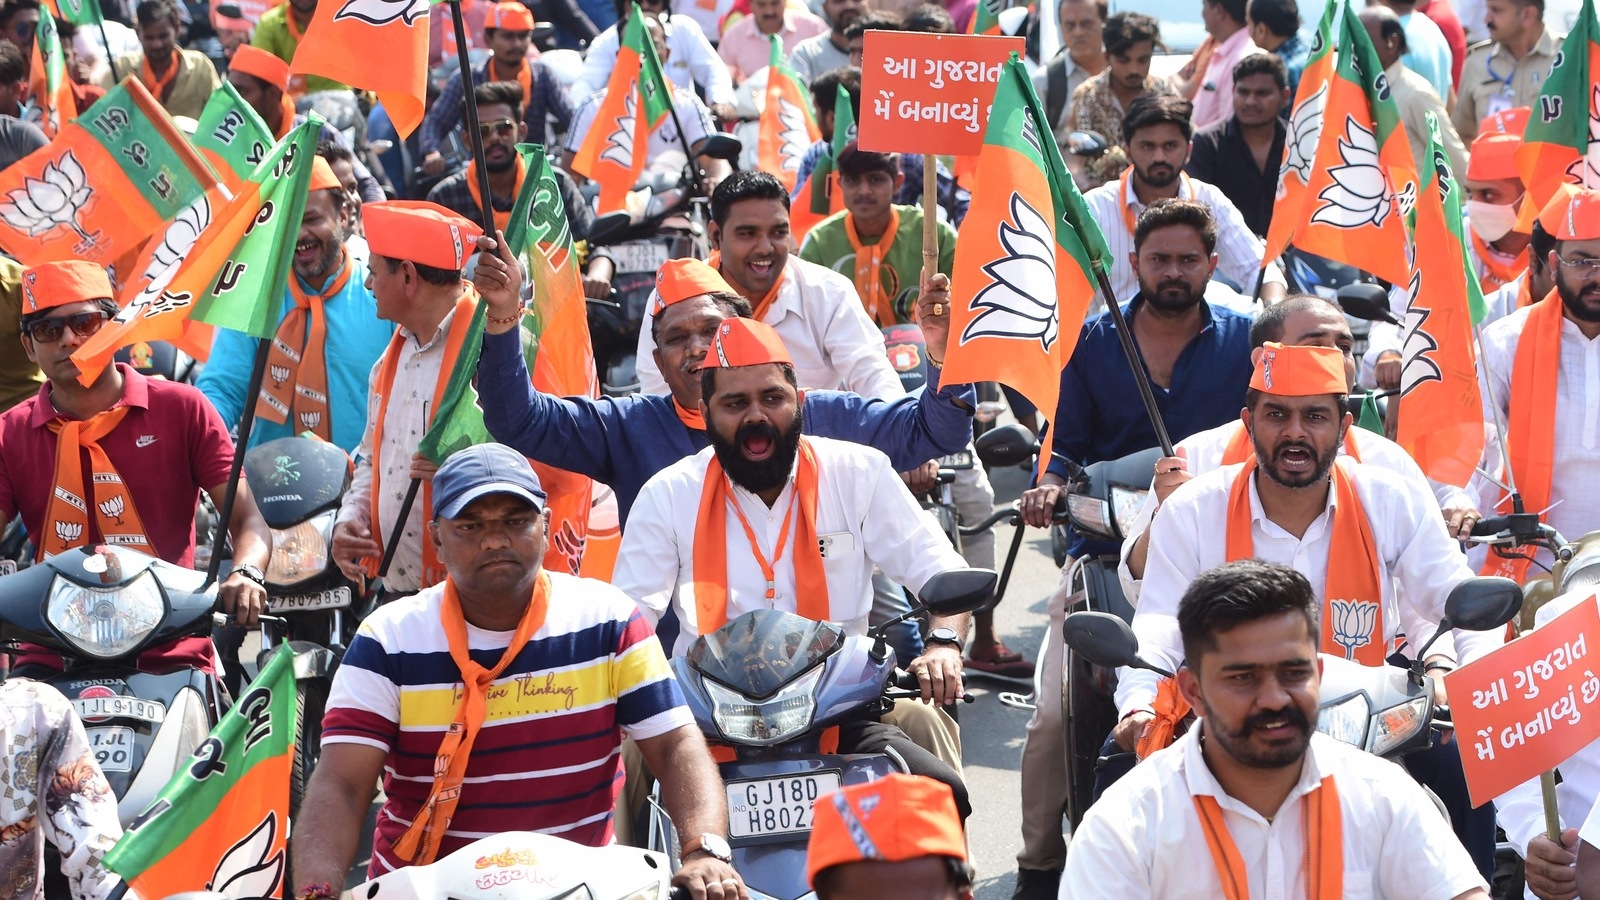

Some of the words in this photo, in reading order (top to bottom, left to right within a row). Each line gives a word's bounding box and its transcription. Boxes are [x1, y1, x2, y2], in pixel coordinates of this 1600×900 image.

[883, 57, 917, 79] આ
[924, 59, 1003, 89] ગુજરાત
[874, 90, 895, 120] મેં
[898, 97, 980, 133] બનાવ્યું
[263, 494, 303, 503] HONDA
[70, 678, 127, 689] HONDA
[1472, 677, 1509, 709] આ
[1512, 632, 1587, 699] ગુજરાત
[514, 671, 578, 711] Thinking
[1474, 726, 1495, 760] મેં
[1500, 684, 1581, 749] બનાવ્યું
[1580, 670, 1600, 704] છે
[746, 778, 818, 807] GJ18D
[732, 805, 747, 813] IND
